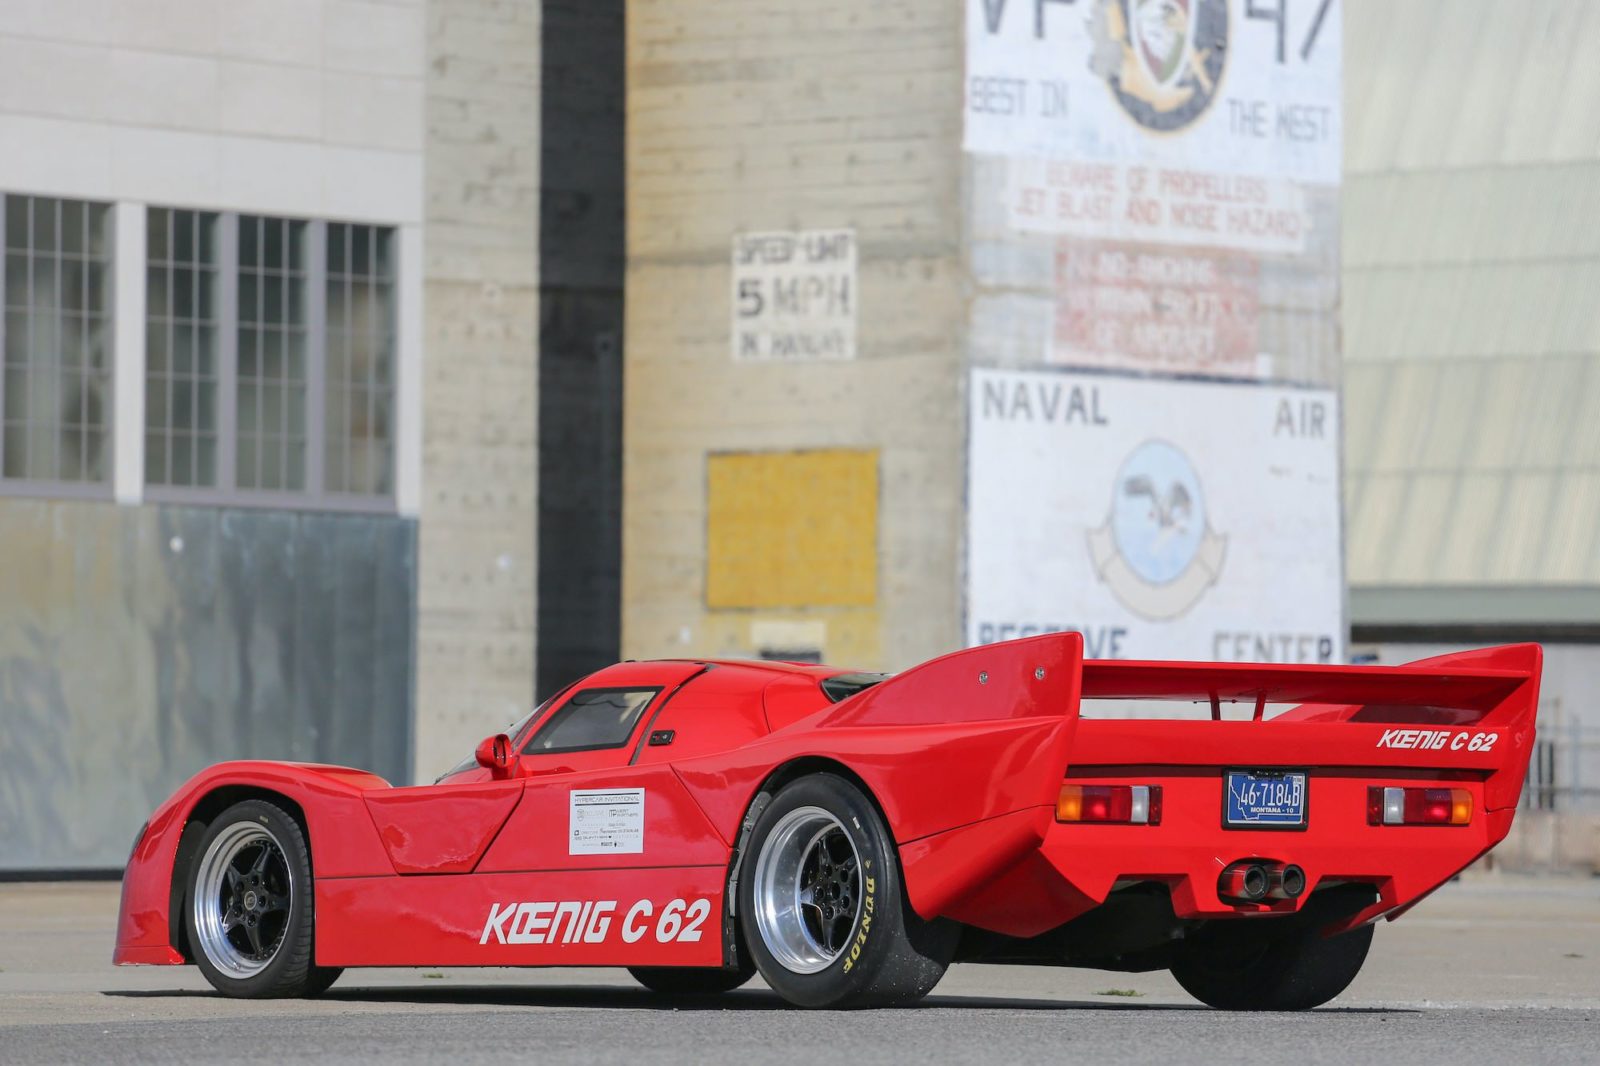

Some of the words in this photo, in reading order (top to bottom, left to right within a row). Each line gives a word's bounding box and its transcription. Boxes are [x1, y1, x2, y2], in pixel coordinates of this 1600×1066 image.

[970, 77, 1027, 115] BEST
[1040, 80, 1068, 117] IN
[1226, 98, 1268, 137] THE
[1276, 105, 1331, 142] NEST
[1127, 166, 1148, 193] OF
[1159, 169, 1268, 203] PROPELLERS
[1015, 188, 1046, 215] JET
[1056, 191, 1112, 219] BLAST
[1125, 198, 1161, 226] AND
[1170, 202, 1218, 231] NOISE
[1226, 208, 1301, 240] HAZARD
[738, 278, 764, 318] 5
[773, 274, 849, 316] MPH
[983, 381, 1108, 425] NAVAL
[1274, 398, 1326, 438] AIR
[1450, 732, 1469, 751] C
[1467, 732, 1498, 752] 62
[621, 899, 653, 944] C
[655, 898, 711, 943] 62
